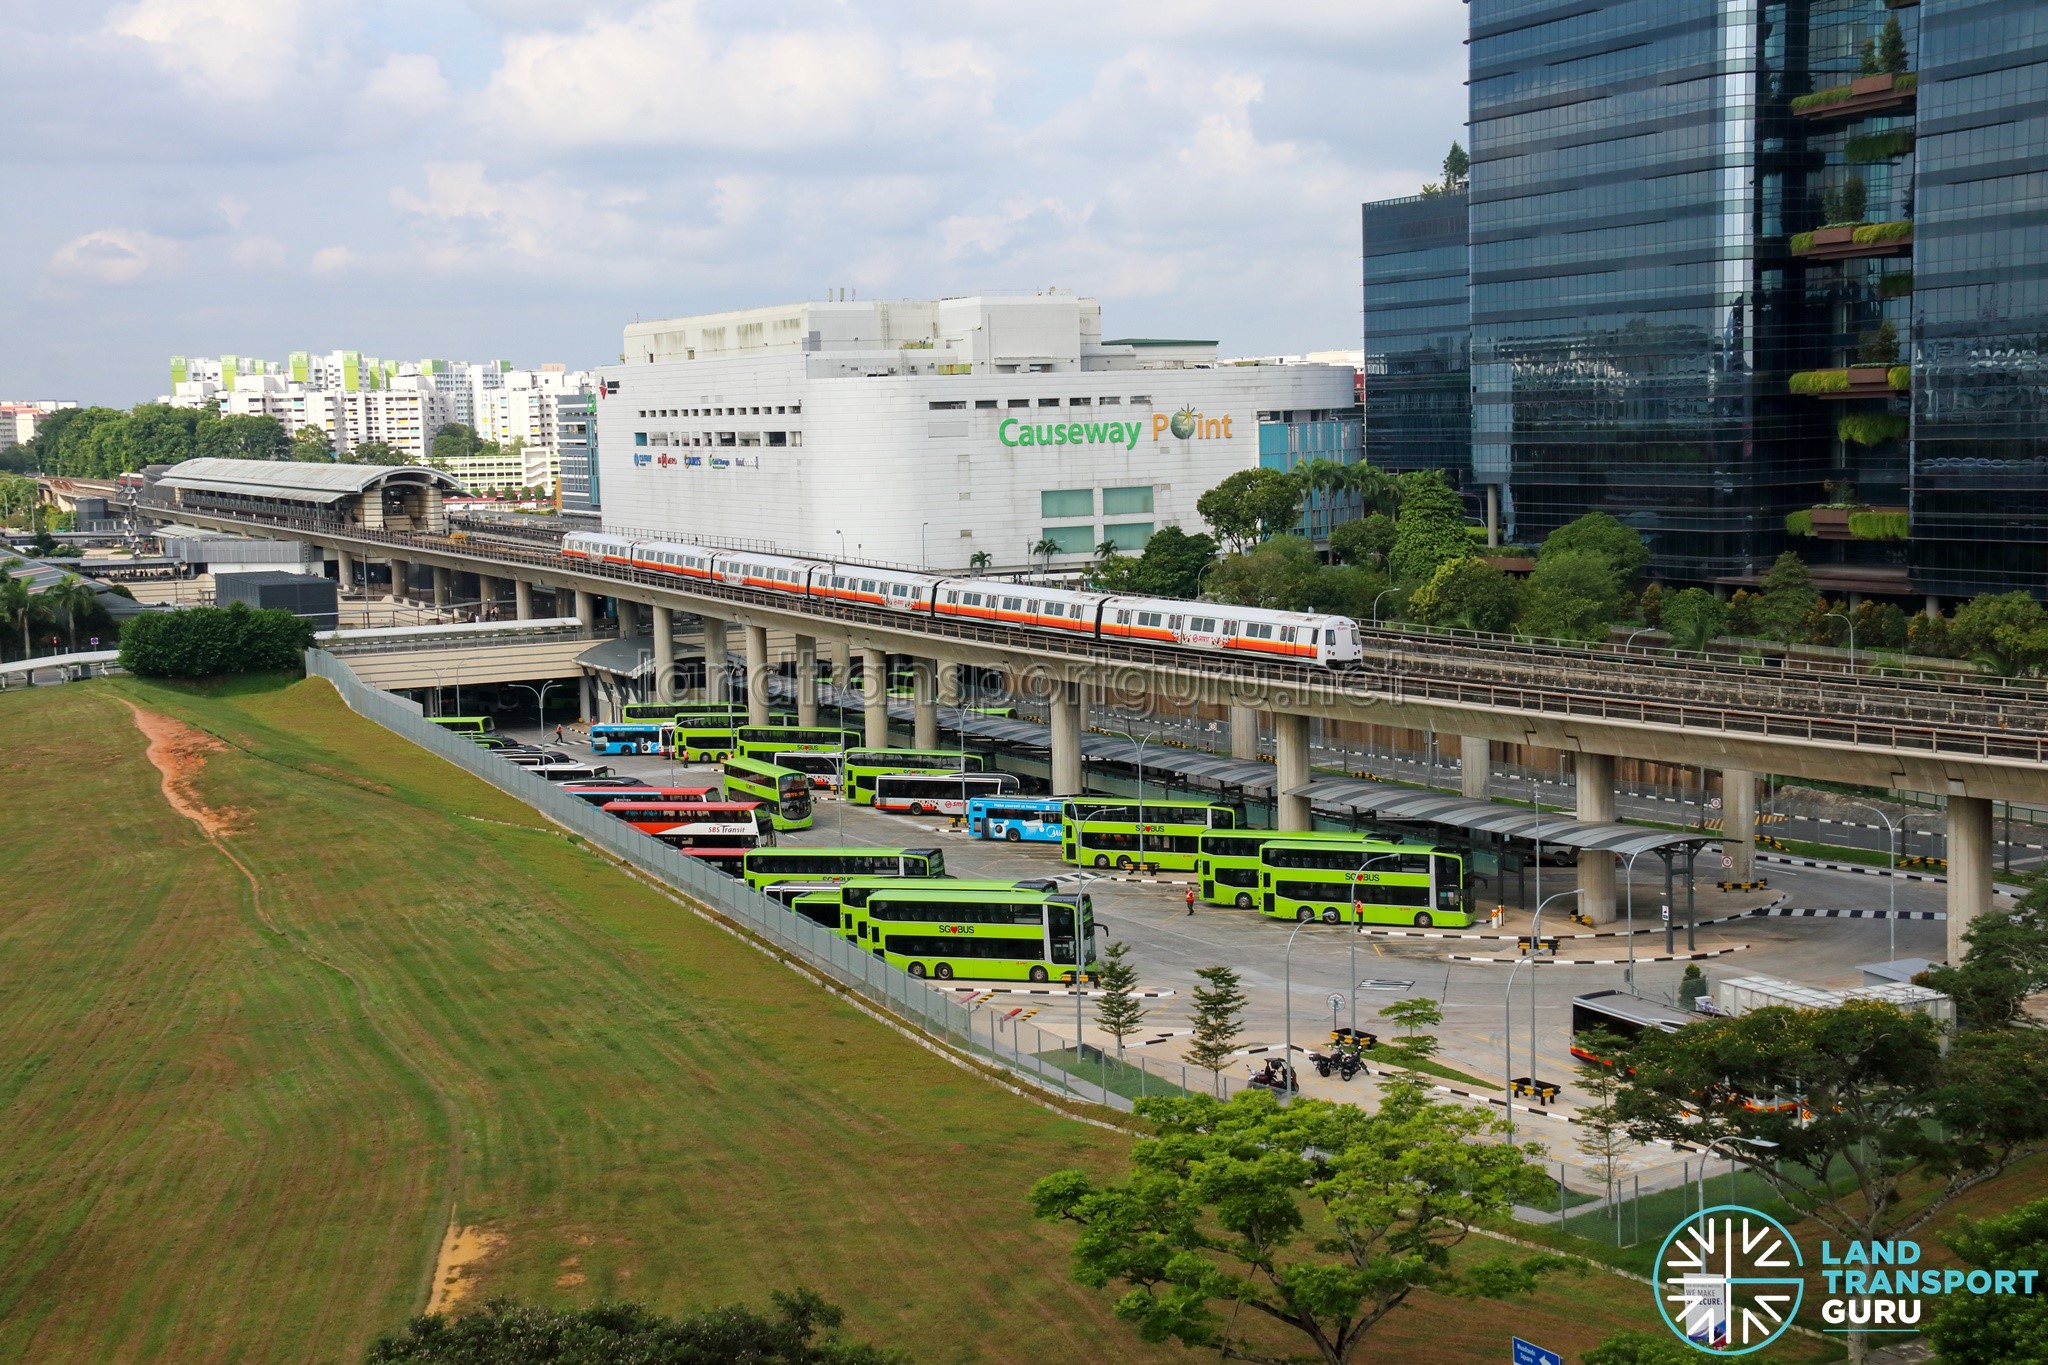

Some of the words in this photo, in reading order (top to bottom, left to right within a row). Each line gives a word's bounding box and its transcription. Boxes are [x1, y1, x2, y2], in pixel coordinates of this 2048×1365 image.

[999, 418, 1142, 450] Causeway
[708, 826, 720, 834] SBS
[721, 824, 745, 834] Transit
[1697, 1289, 1716, 1297] MAKE
